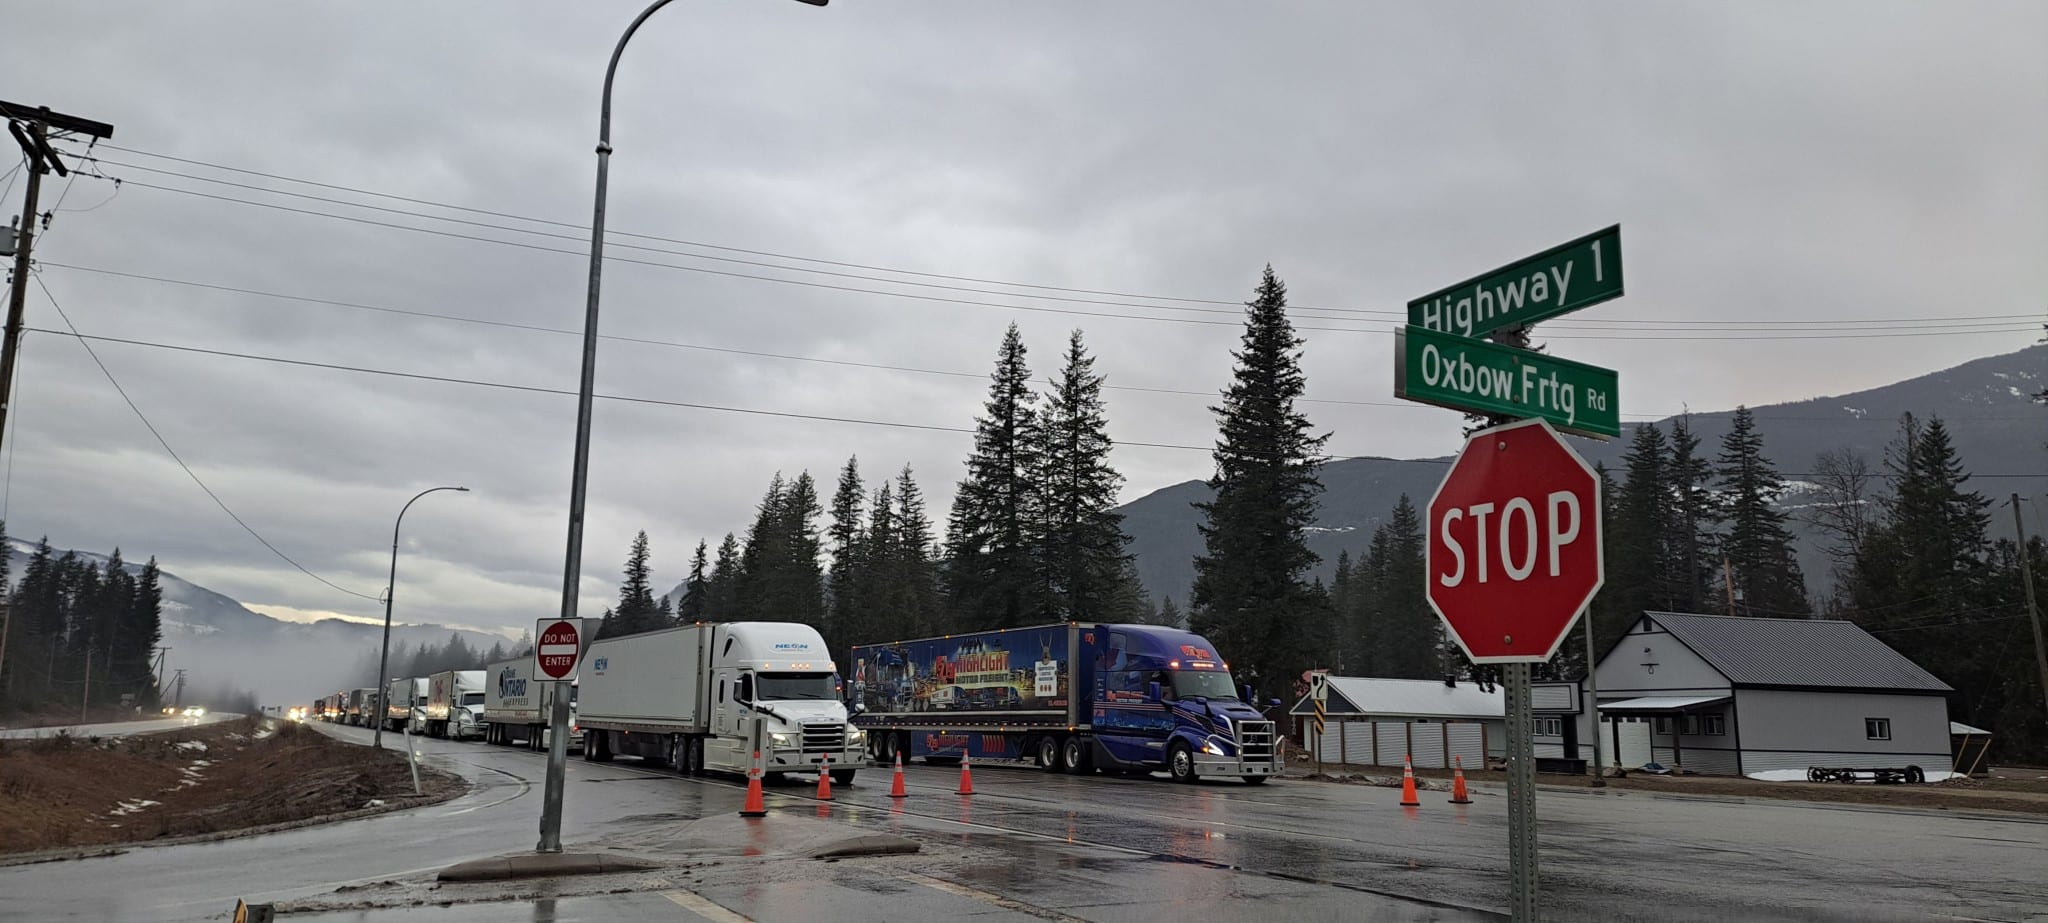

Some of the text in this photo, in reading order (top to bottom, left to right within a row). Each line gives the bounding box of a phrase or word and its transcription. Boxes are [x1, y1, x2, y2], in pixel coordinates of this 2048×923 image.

[1423, 239, 1603, 338] Highway 1
[1421, 344, 1606, 426] Oxbow Frtg Rd
[1440, 490, 1581, 588] STOP
[544, 633, 576, 643] DO NOT
[545, 656, 571, 666] ENTER
[956, 654, 1009, 673] HIGHLIGHT
